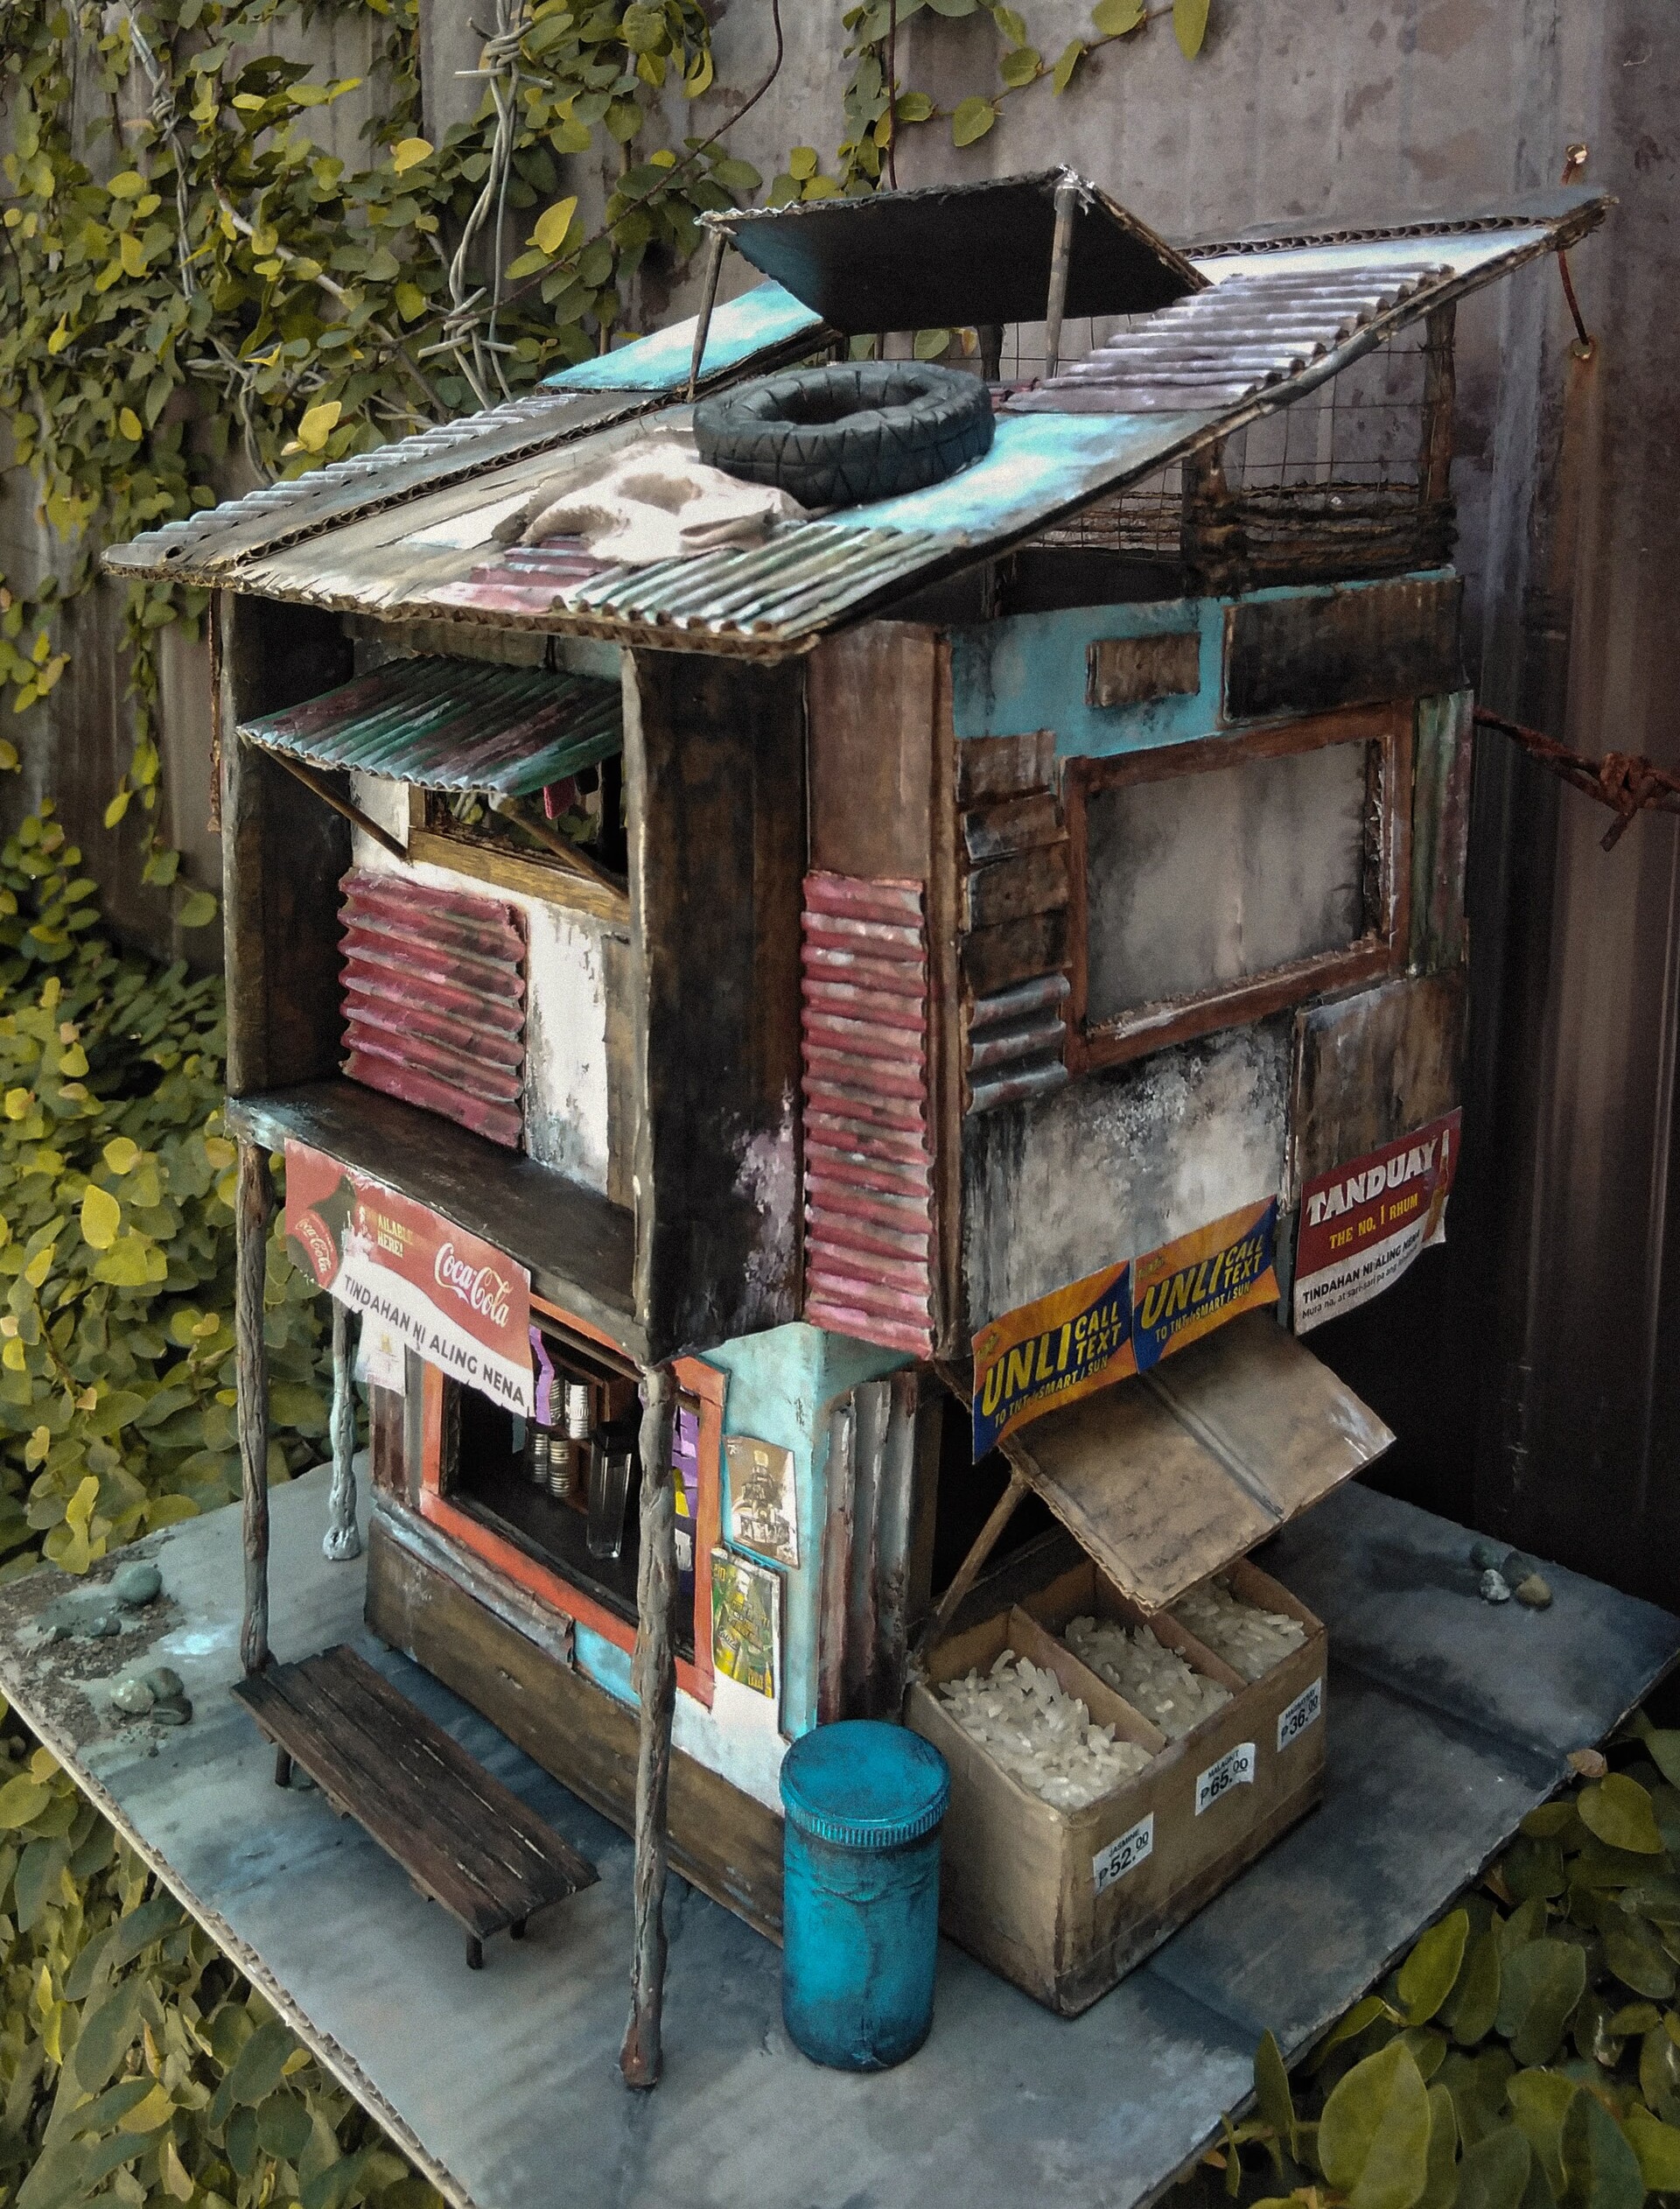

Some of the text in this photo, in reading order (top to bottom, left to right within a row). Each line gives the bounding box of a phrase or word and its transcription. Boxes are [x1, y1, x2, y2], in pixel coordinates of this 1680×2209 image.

[1306, 1137, 1438, 1226] TANDUAY
[376, 1228, 404, 1259] HERE!
[1225, 1234, 1264, 1266] CALL
[1329, 1227, 1354, 1250] THE
[1358, 1217, 1376, 1237] NO.
[1390, 1193, 1418, 1221] RHUM
[434, 1243, 513, 1328] Coca-Cola
[1141, 1252, 1225, 1329] UNLI
[1224, 1252, 1263, 1289] TEXT
[1302, 1267, 1360, 1304] TINDAHAN
[1362, 1261, 1373, 1277] NI
[1375, 1245, 1402, 1270] ALING
[1074, 1301, 1118, 1340] CALL
[1155, 1325, 1167, 1343] TO
[1195, 1294, 1226, 1321] SMART
[1232, 1280, 1251, 1300] SUN
[1302, 1302, 1322, 1320] Mura
[344, 1274, 524, 1407] TINDAHAN NI ALING NENA
[1075, 1322, 1122, 1365] TEXT
[982, 1323, 1072, 1417] UNLI
[995, 1408, 1006, 1428] TO
[1038, 1370, 1079, 1399] SMART
[1088, 1355, 1108, 1377] SUN
[1109, 1828, 1141, 1857] JASMINE
